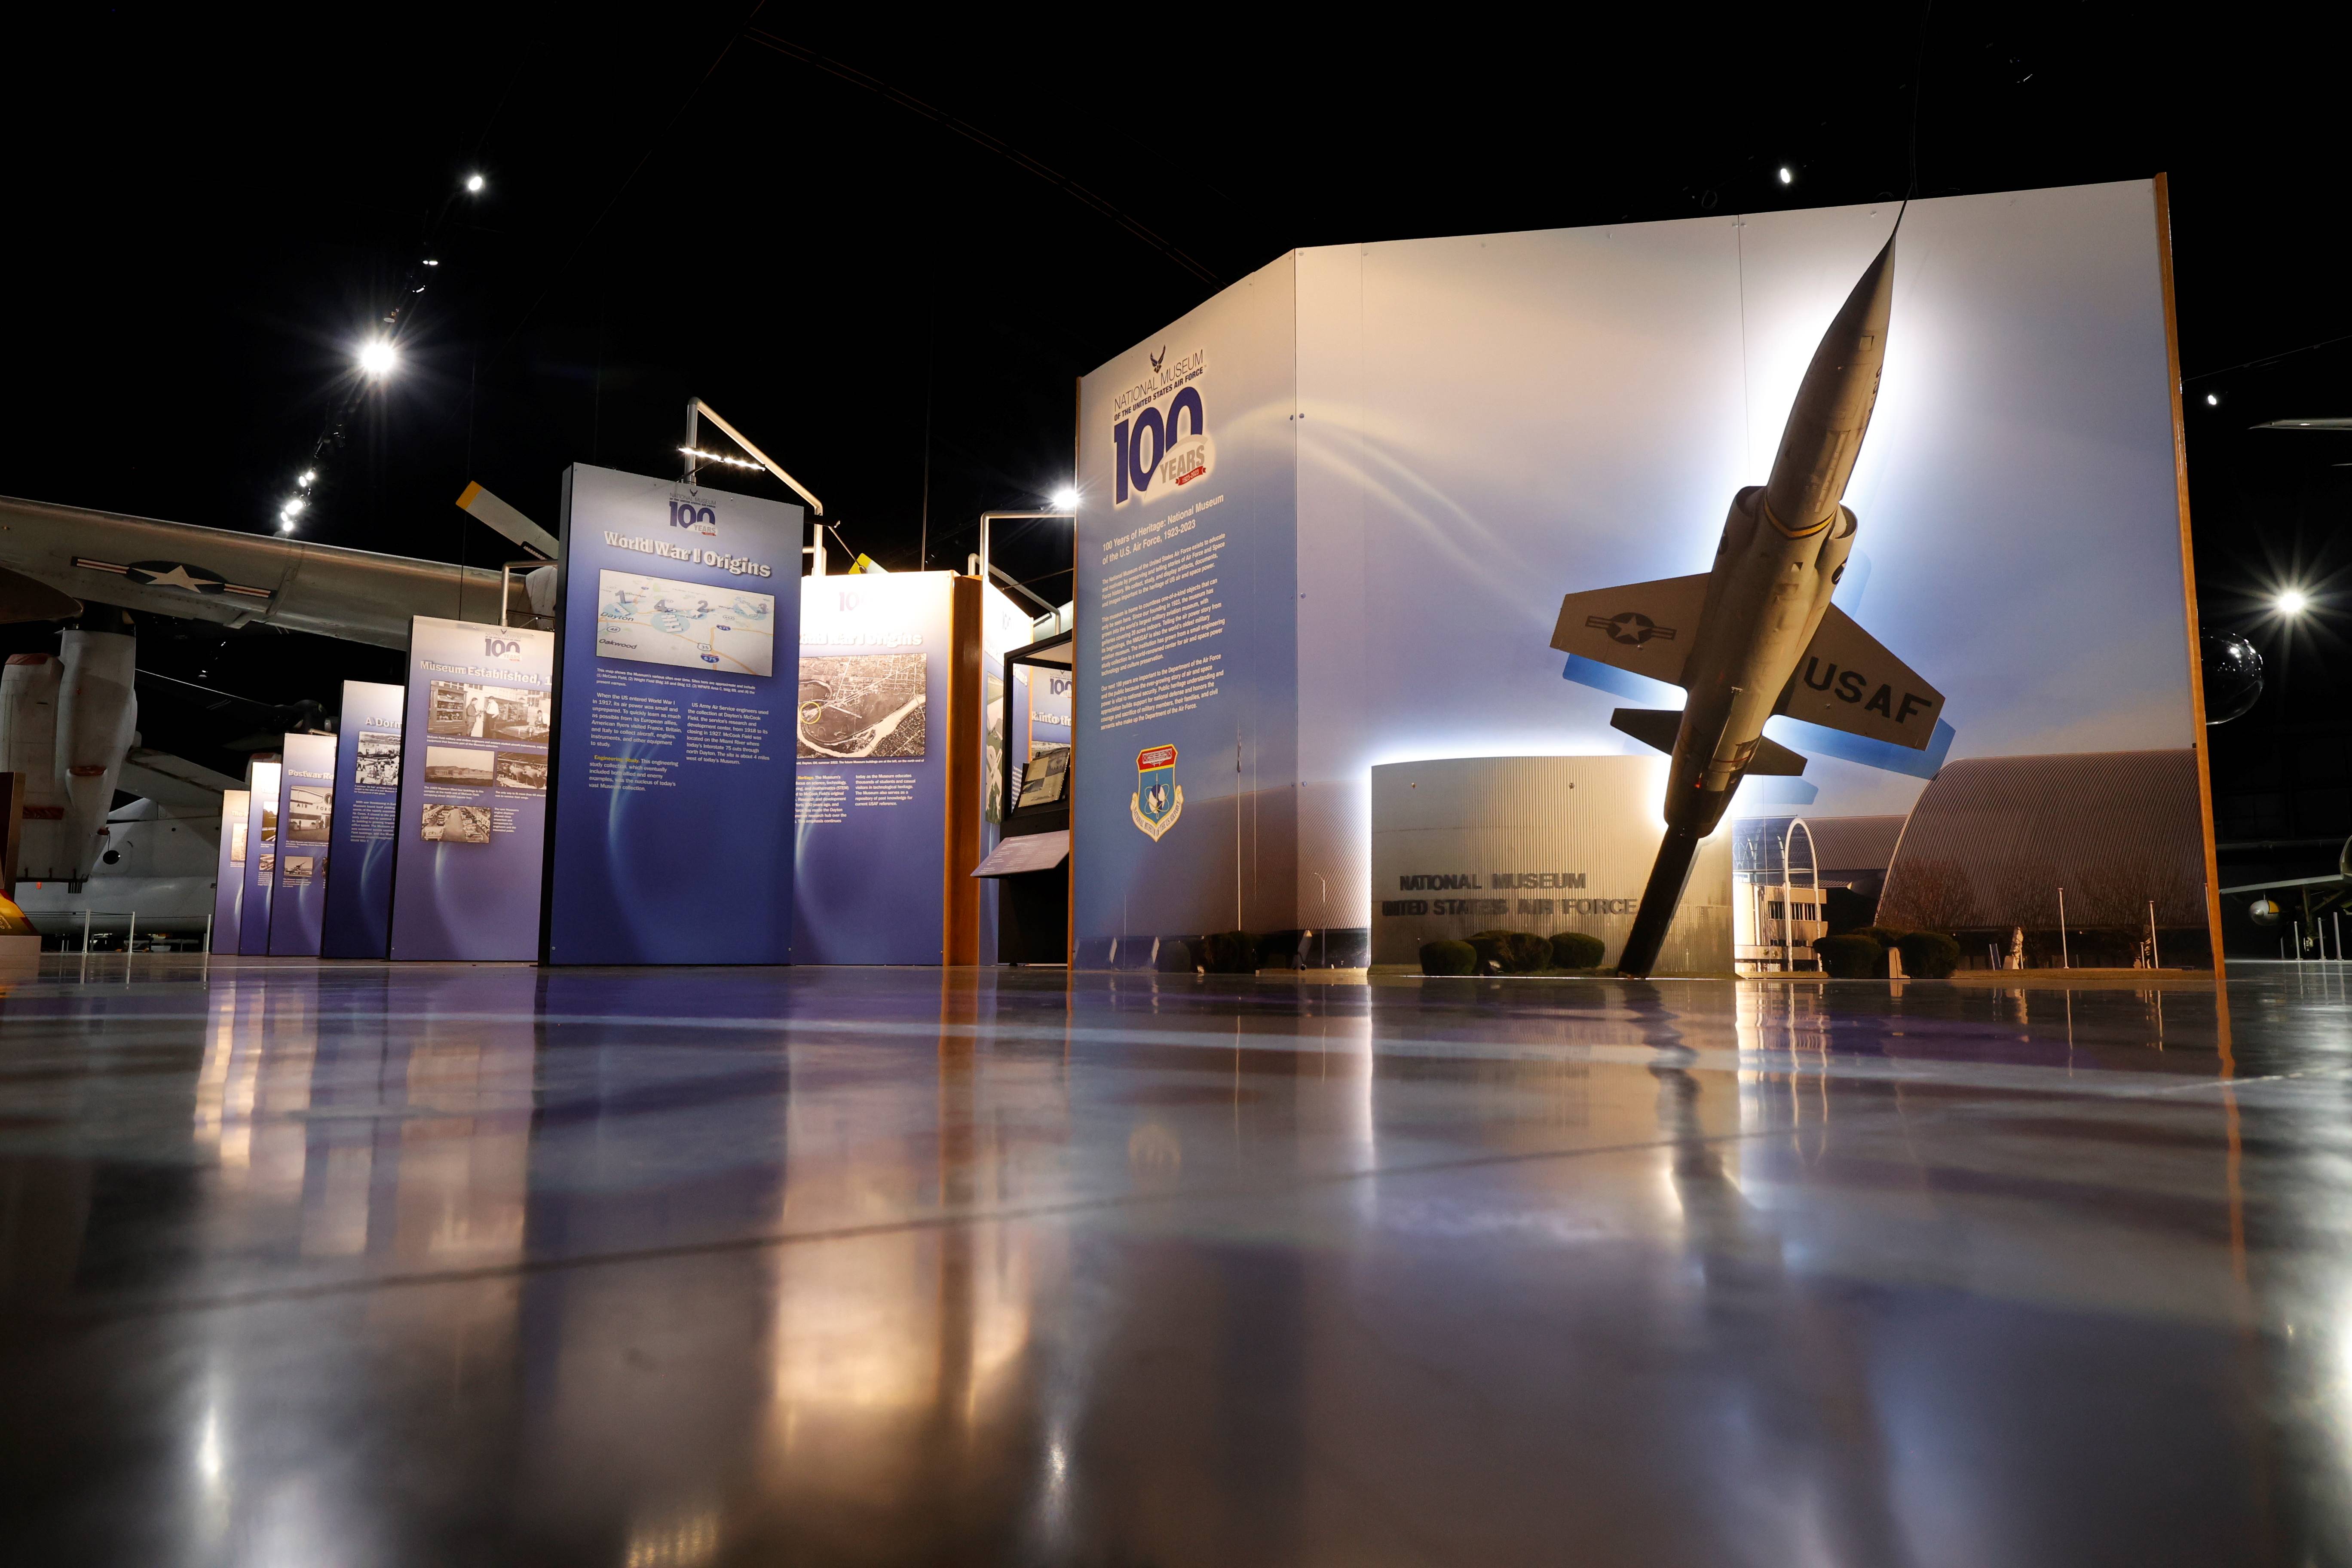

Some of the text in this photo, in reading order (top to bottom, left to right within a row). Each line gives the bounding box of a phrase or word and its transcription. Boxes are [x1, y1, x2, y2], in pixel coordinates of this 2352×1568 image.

[1115, 349, 1203, 411] NATIONAL MUSEUM
[1114, 367, 1203, 421] OF THE UNITED STATES AIR FORCE
[1114, 386, 1203, 505] 100
[1160, 444, 1204, 484] YEARS
[1182, 470, 1199, 484] 1923-2023
[670, 493, 694, 501] NATIONAL
[669, 501, 715, 528] 100
[1103, 495, 1224, 551] 100 Years of Heritage: National Museum
[694, 524, 716, 533] YEARS
[1102, 519, 1196, 565] of the U.S. Air Force, 1923-2023
[604, 530, 771, 577] World War I Origins
[1121, 590, 1137, 600] important
[1149, 581, 1164, 590] heritage
[1189, 568, 1200, 576] space
[1201, 564, 1214, 573] power.
[615, 590, 626, 603] 1
[654, 600, 668, 612] 4
[697, 600, 708, 612] 2
[600, 612, 634, 622] Dayton
[485, 638, 520, 657] 100
[599, 639, 637, 649] Oakwood
[420, 660, 467, 674] Museum
[468, 667, 542, 686] Established,
[1139, 671, 1156, 681] important
[1168, 662, 1190, 673] Department
[1804, 656, 1932, 723] USAF
[366, 717, 375, 725] A
[1039, 711, 1060, 725] into
[288, 769, 323, 779] Postwar
[1400, 873, 1586, 890] NATIONAL MUSEUM
[1382, 898, 1638, 916] UNITED STATES AIR FORCE
